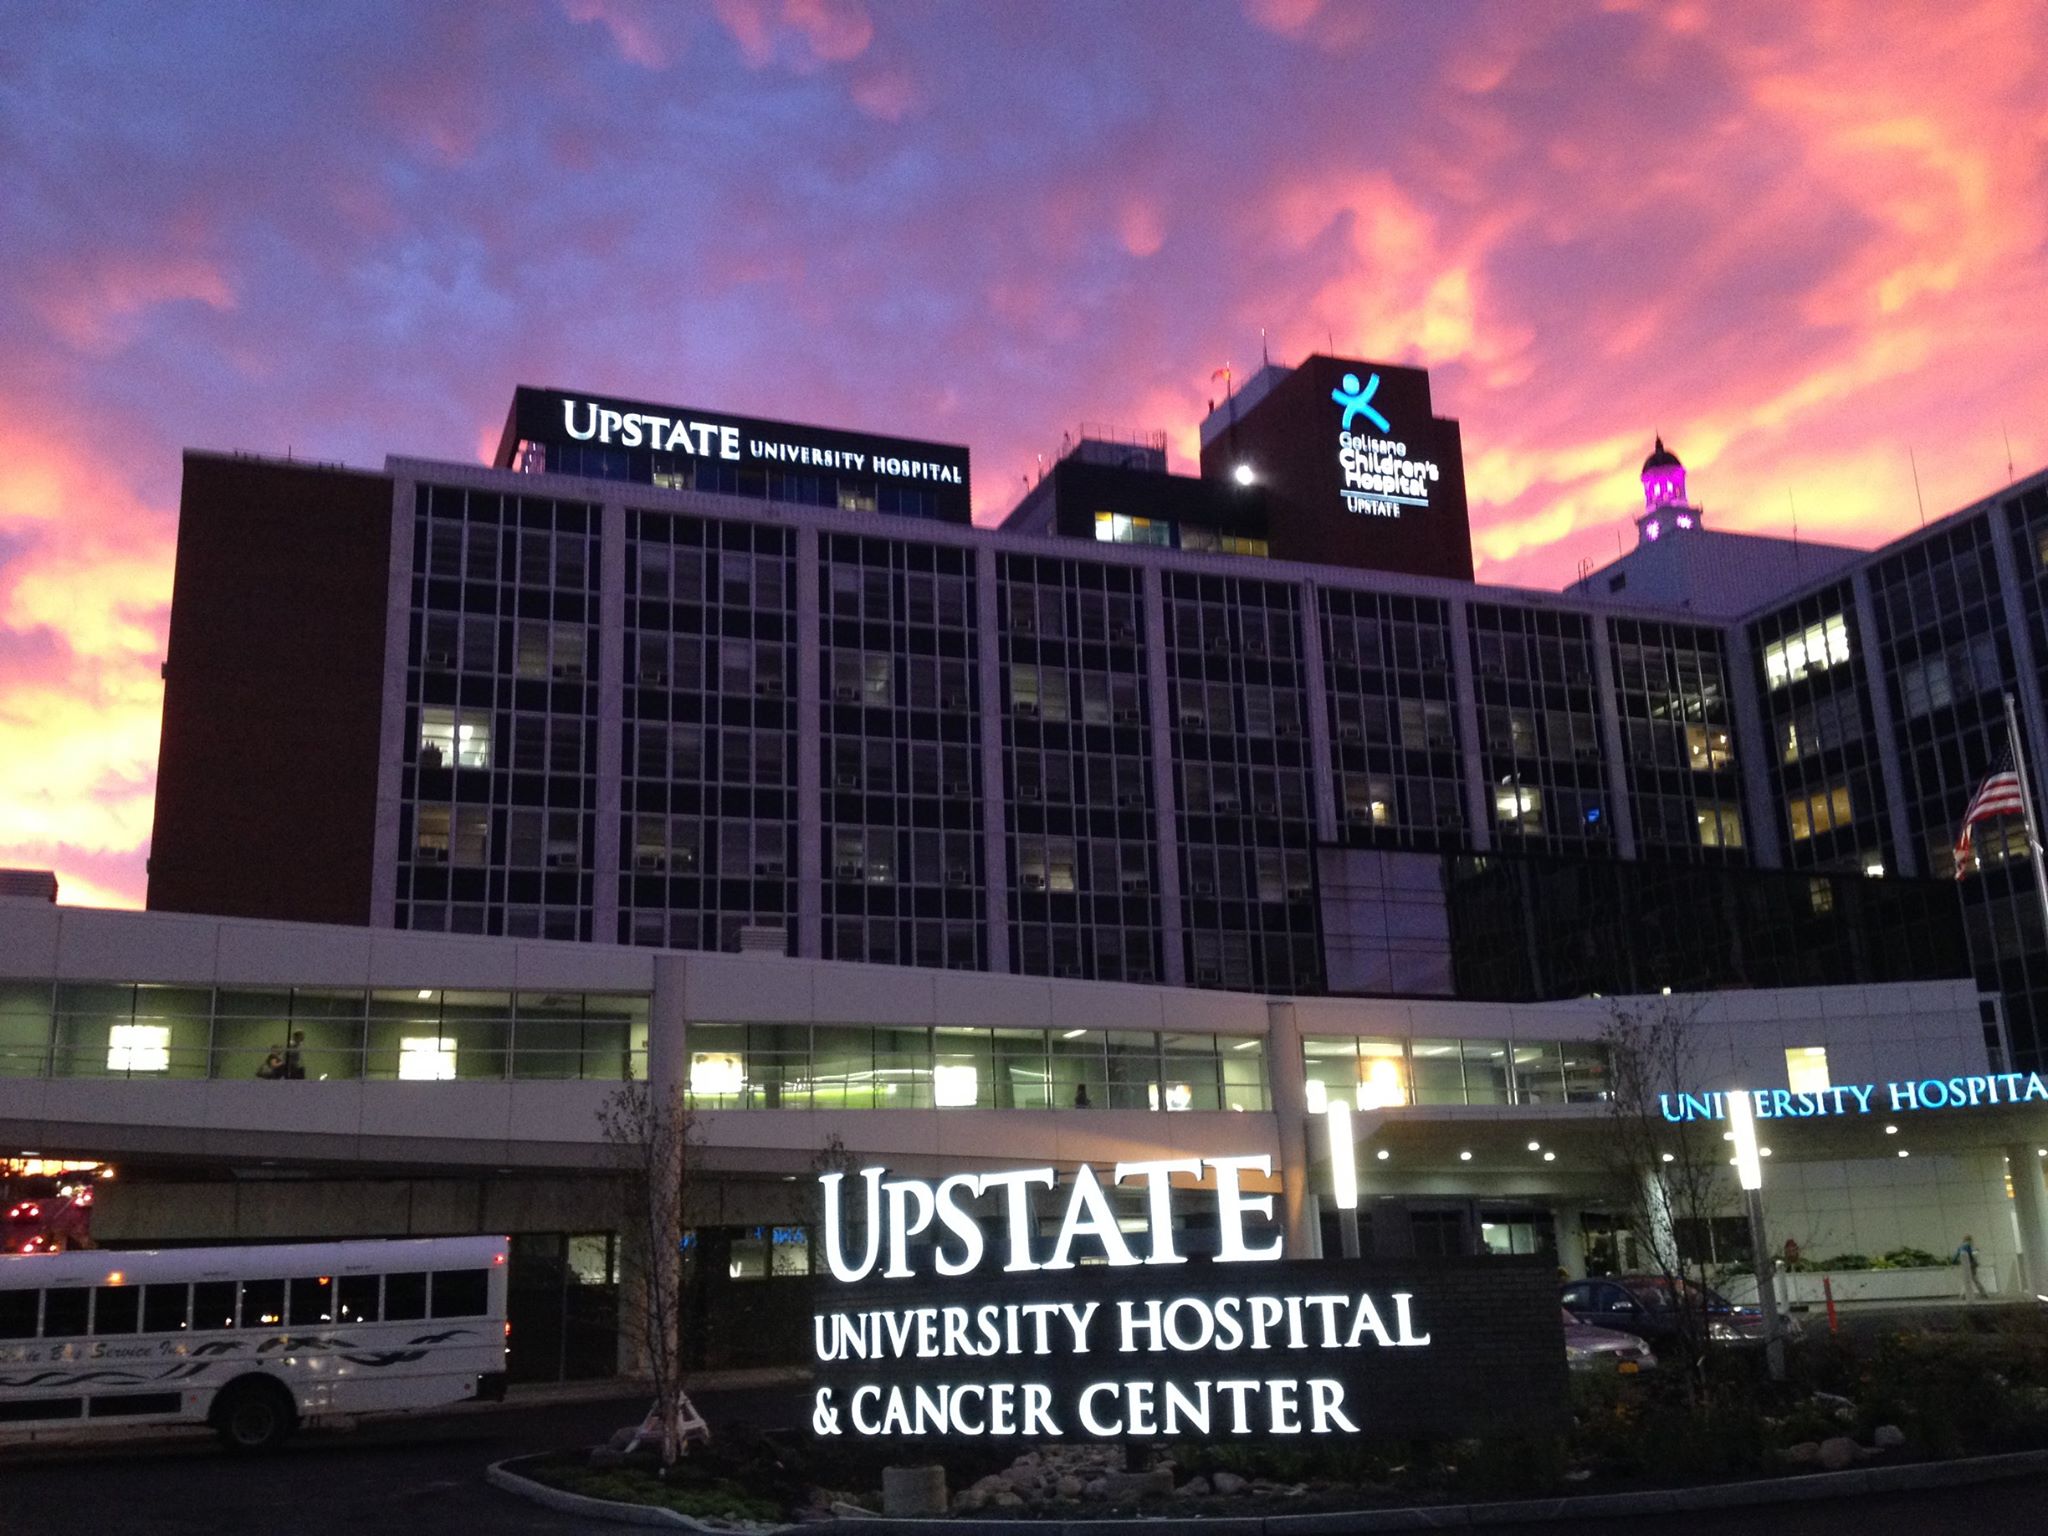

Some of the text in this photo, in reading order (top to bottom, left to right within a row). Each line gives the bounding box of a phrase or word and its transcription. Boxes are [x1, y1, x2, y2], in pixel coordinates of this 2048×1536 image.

[563, 400, 962, 484] UPSTATE UNIVERSITY HOSPITAL
[1339, 431, 1406, 457] Golisano
[1339, 448, 1439, 482] Children's
[1345, 467, 1428, 497] Hospital
[1347, 496, 1400, 519] UPSTATE
[1659, 1071, 2048, 1122] UNIERSITY HOSPITA
[818, 1154, 1283, 1282] UPSTATE
[814, 1293, 1431, 1361] UNIVERSITY HOSPITAL
[50, 1344, 82, 1361] Bs
[90, 1342, 152, 1360] Service
[813, 1379, 1360, 1436] & CANCER CENTER
